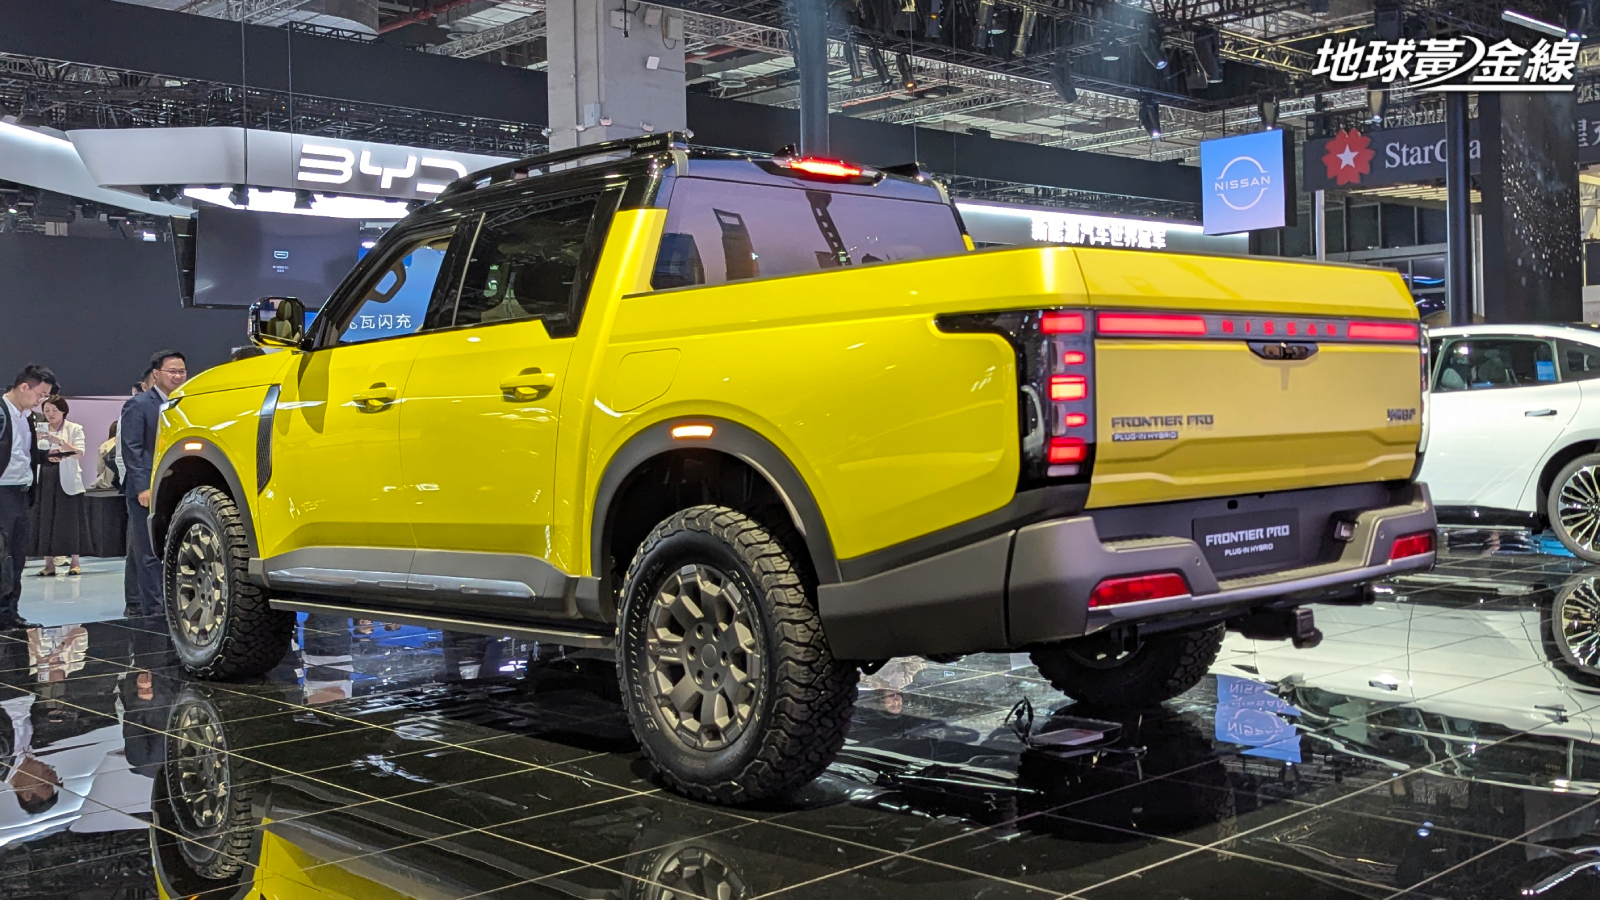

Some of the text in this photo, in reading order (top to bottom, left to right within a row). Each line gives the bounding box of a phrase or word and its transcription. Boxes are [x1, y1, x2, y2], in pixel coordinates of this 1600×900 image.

[637, 140, 660, 149] NISSAN
[297, 143, 468, 194] BYD
[1214, 175, 1271, 191] NISSAN
[1221, 320, 1337, 337] NISSAN
[1111, 414, 1214, 428] FRONTIER PRO
[1114, 431, 1177, 441] PLUG-IN HYBRID
[1205, 524, 1290, 547] FRONTIER PRO
[1224, 542, 1274, 557] PLUG-IN HYBRID
